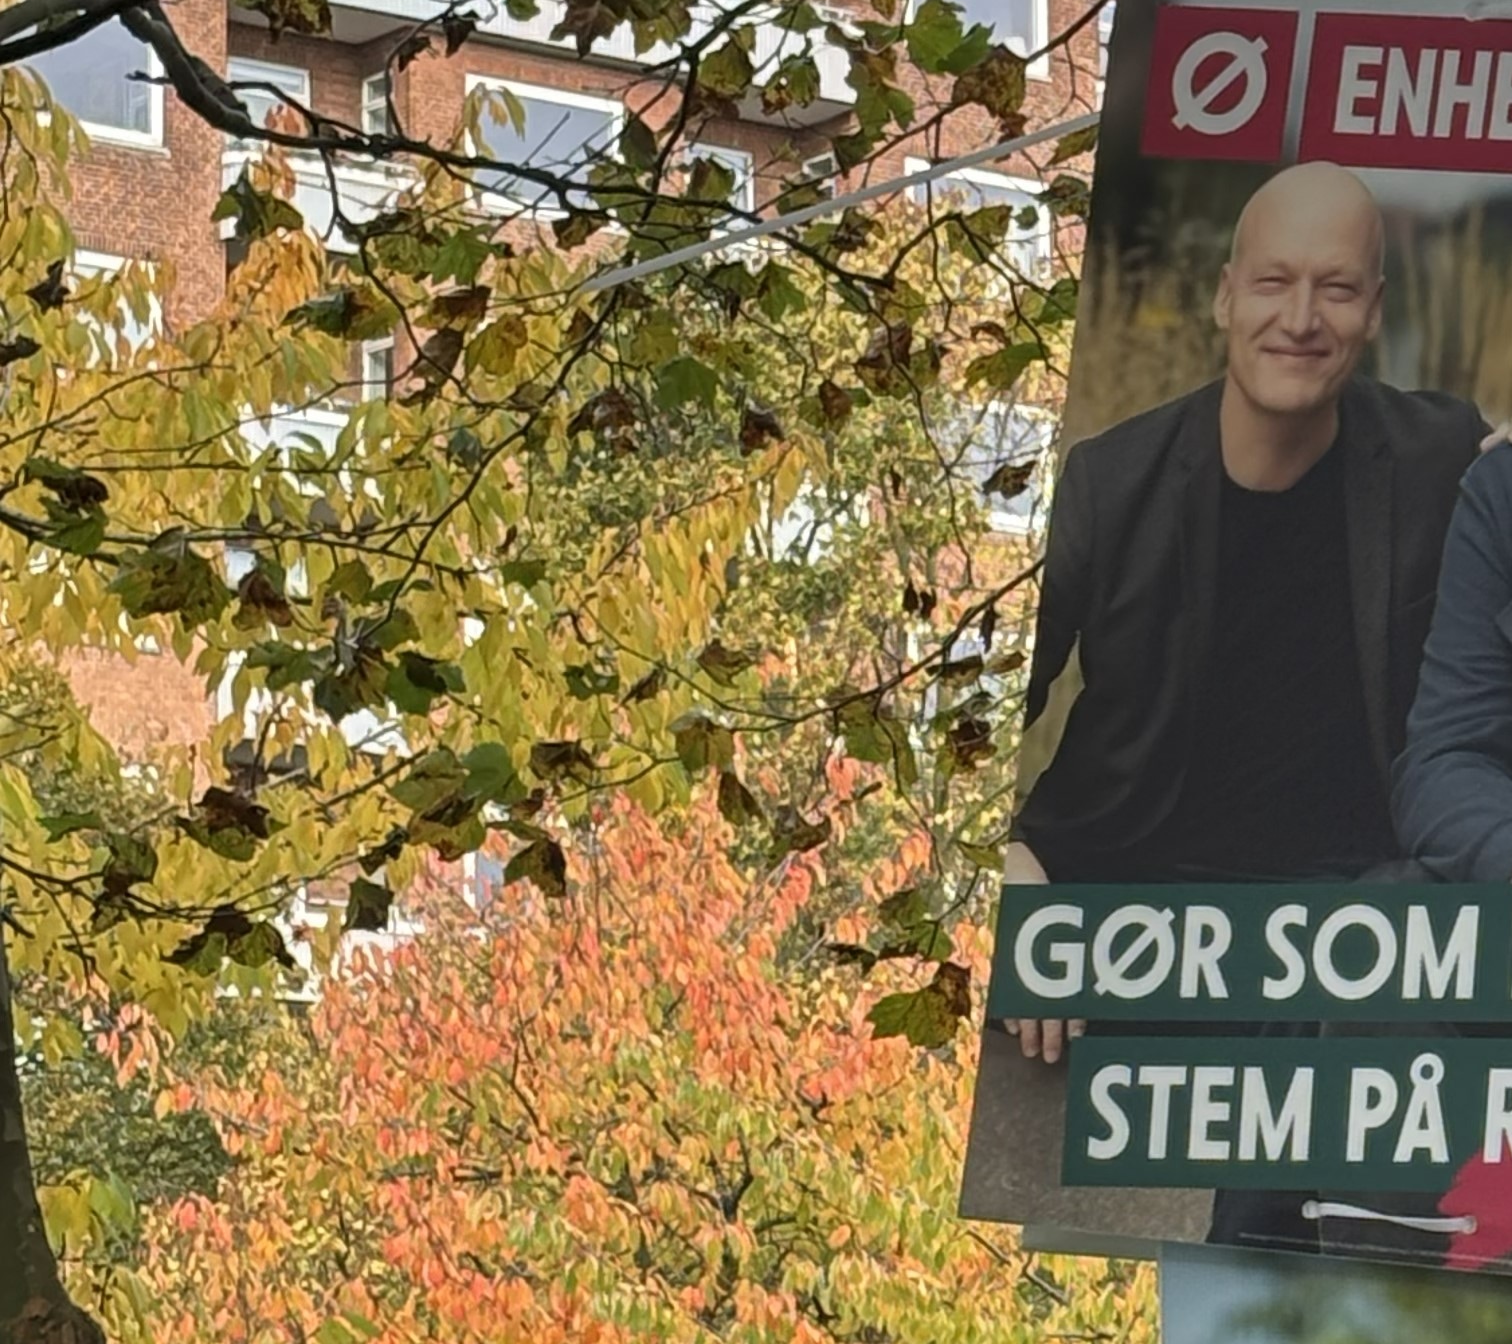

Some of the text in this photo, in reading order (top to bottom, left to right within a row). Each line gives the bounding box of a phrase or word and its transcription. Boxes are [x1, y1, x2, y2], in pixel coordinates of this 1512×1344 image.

[1173, 31, 1268, 136] Ø
[1013, 903, 1233, 1000] GØR
[1262, 903, 1480, 1001] SOM
[1086, 1063, 1315, 1162] STEM
[1345, 1051, 1451, 1164] PÅ
